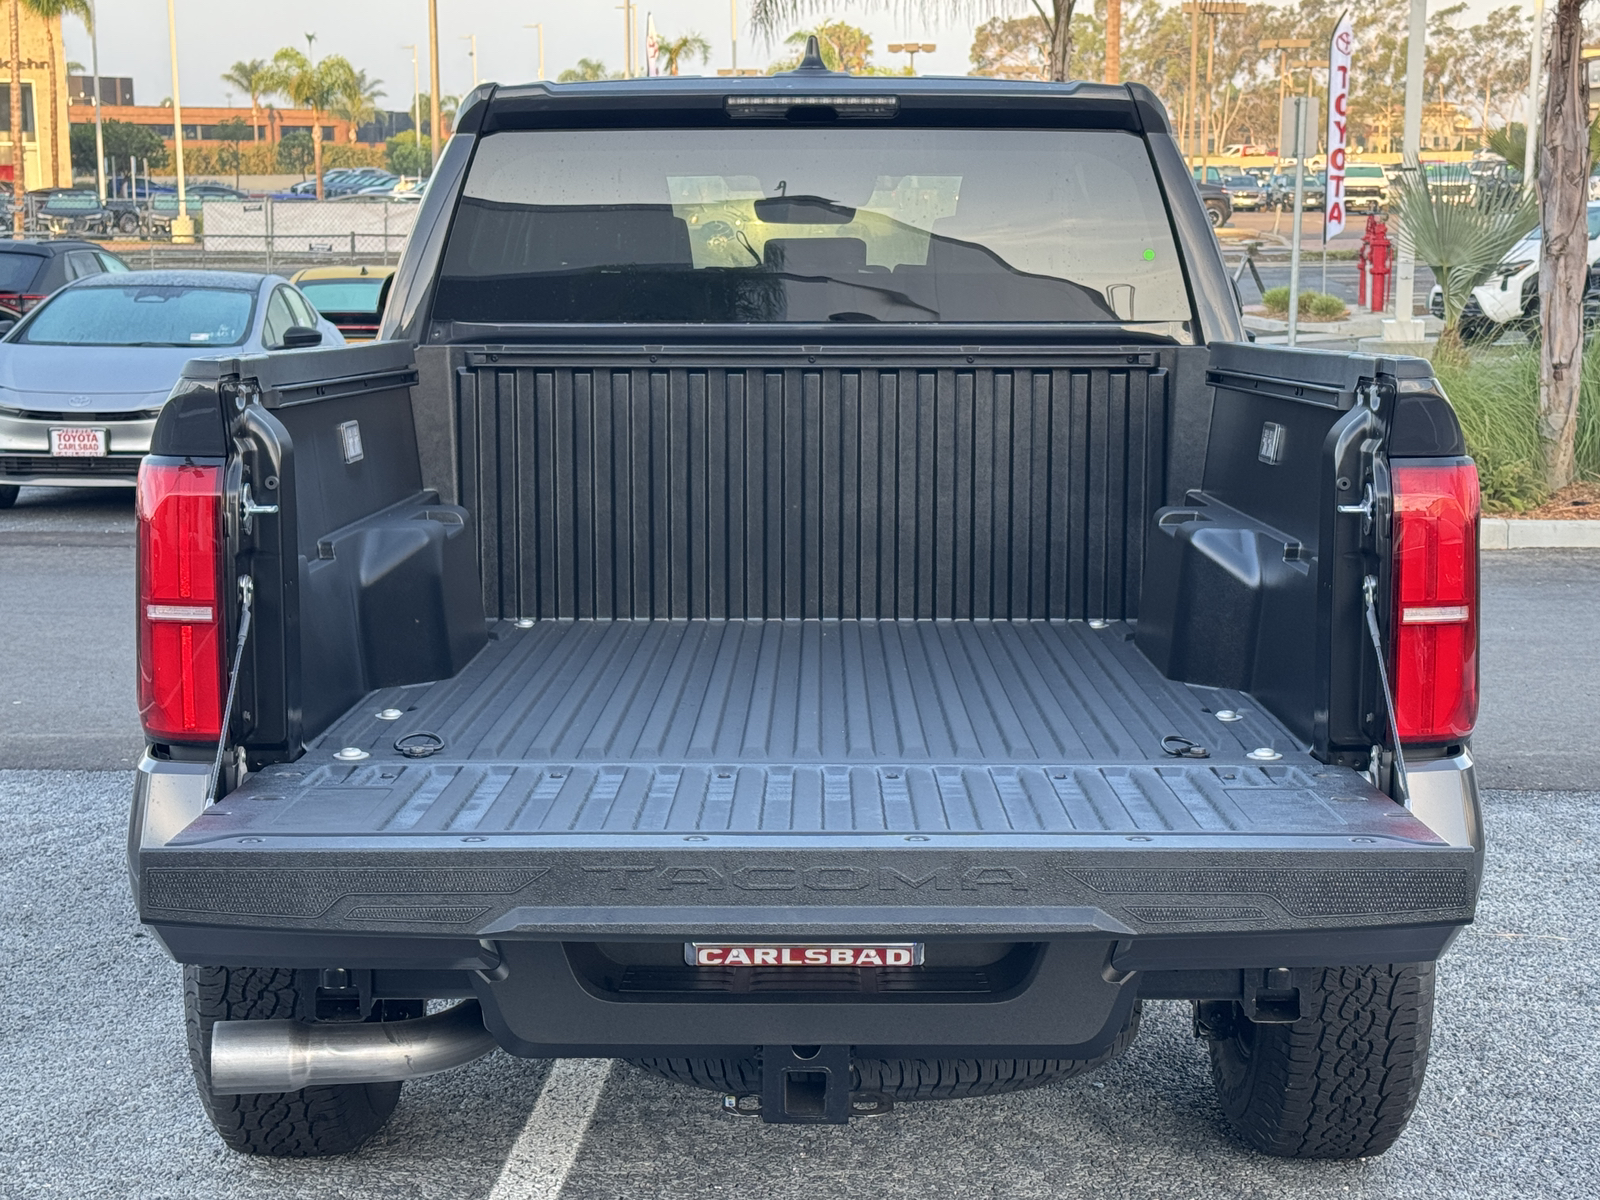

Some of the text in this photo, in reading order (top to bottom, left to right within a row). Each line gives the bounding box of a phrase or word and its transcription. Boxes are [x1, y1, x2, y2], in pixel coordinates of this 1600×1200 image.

[1328, 65, 1348, 225] TOYOTA
[57, 433, 98, 443] TOYOTA
[57, 443, 99, 451] CARLSBAD
[581, 865, 1028, 892] TACOMA
[698, 949, 911, 966] CARLSBAD
